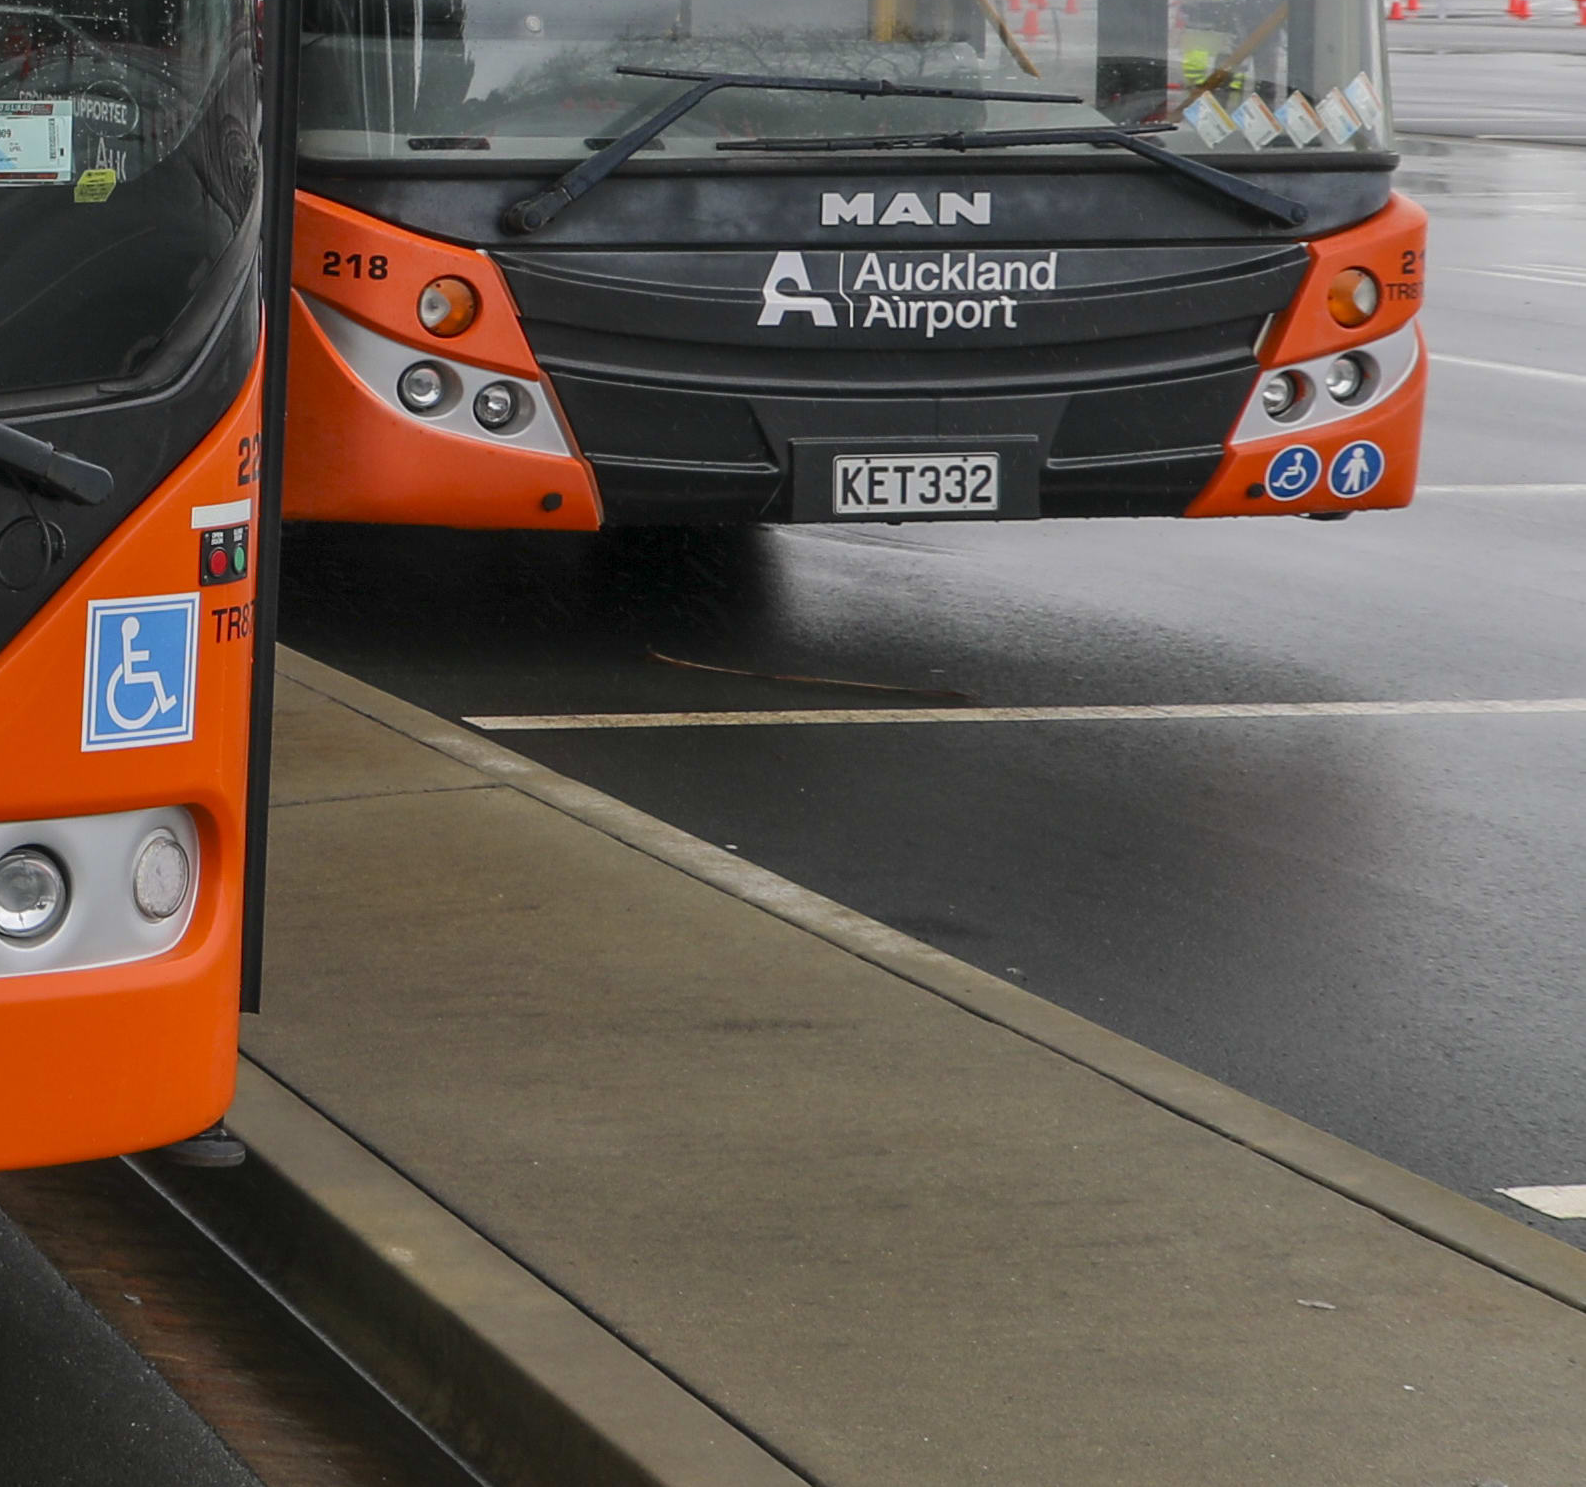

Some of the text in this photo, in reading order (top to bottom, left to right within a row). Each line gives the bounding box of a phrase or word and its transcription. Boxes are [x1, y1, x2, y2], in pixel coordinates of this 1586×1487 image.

[820, 191, 992, 226] MAN
[321, 250, 389, 281] 218
[852, 250, 1059, 292] Auckland
[862, 295, 1018, 338] Airport
[840, 463, 993, 505] KET332
